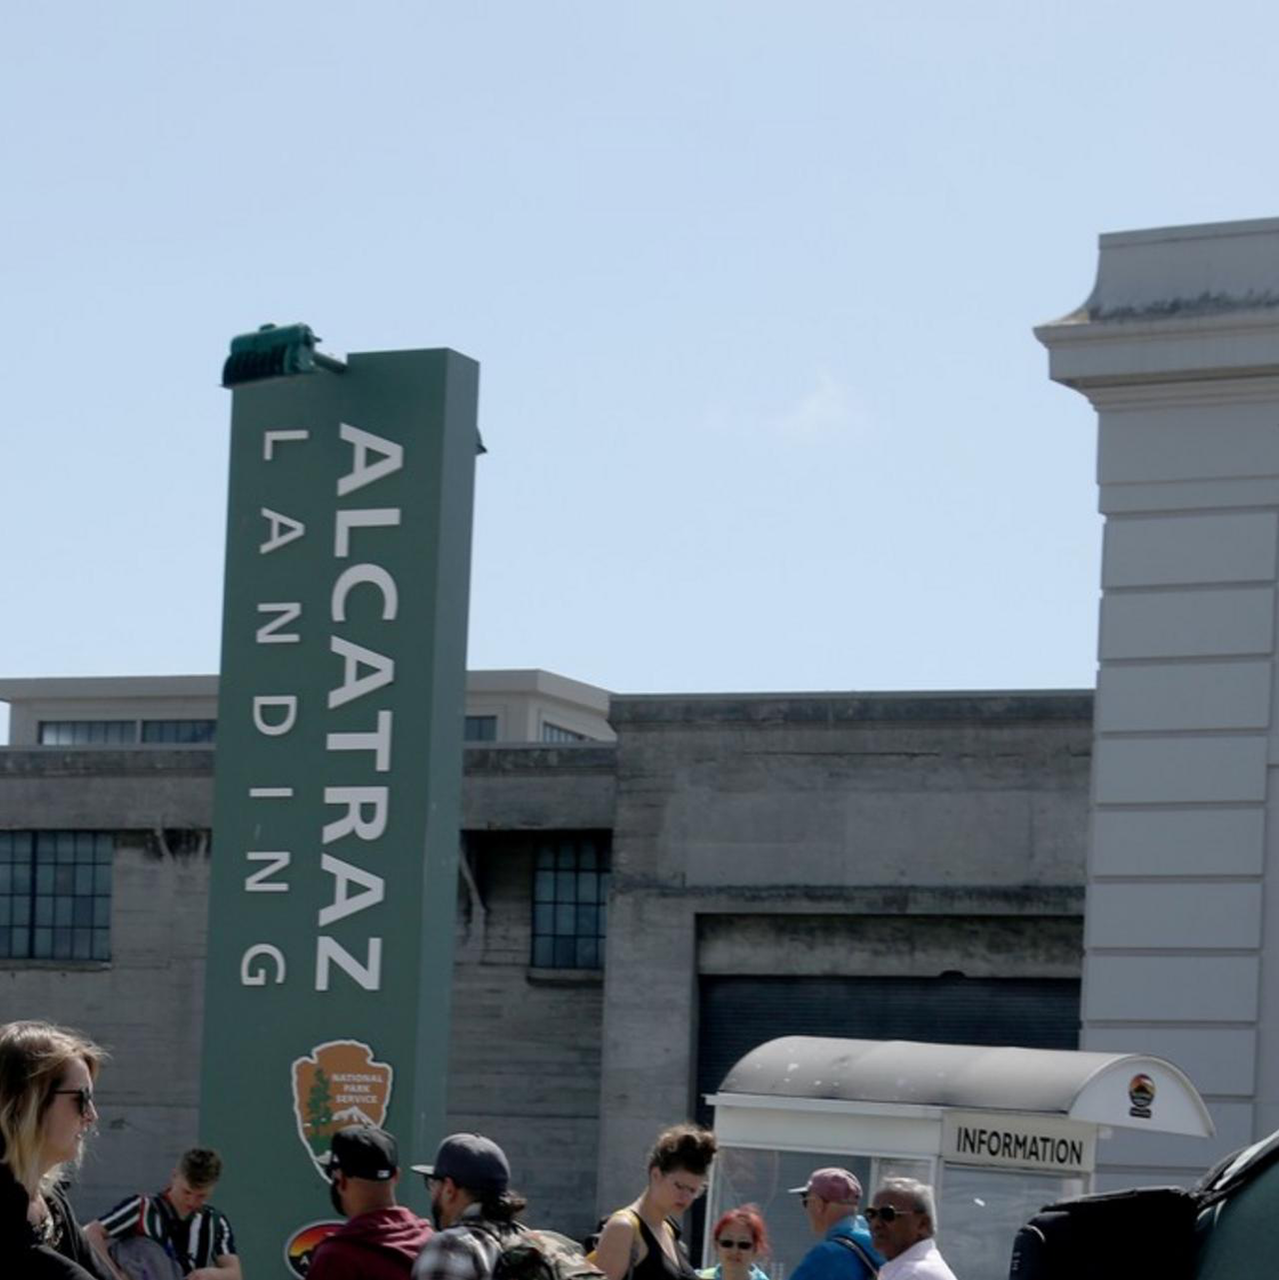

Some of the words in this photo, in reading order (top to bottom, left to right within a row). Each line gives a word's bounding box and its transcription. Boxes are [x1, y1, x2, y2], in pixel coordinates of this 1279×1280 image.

[240, 428, 309, 987] LANDING
[314, 423, 405, 992] ALCATRAZ
[332, 1073, 383, 1083] NATIONAL
[343, 1084, 371, 1093] PARK
[335, 1094, 378, 1104] SERVICE
[957, 1126, 1083, 1165] INFORMATION
